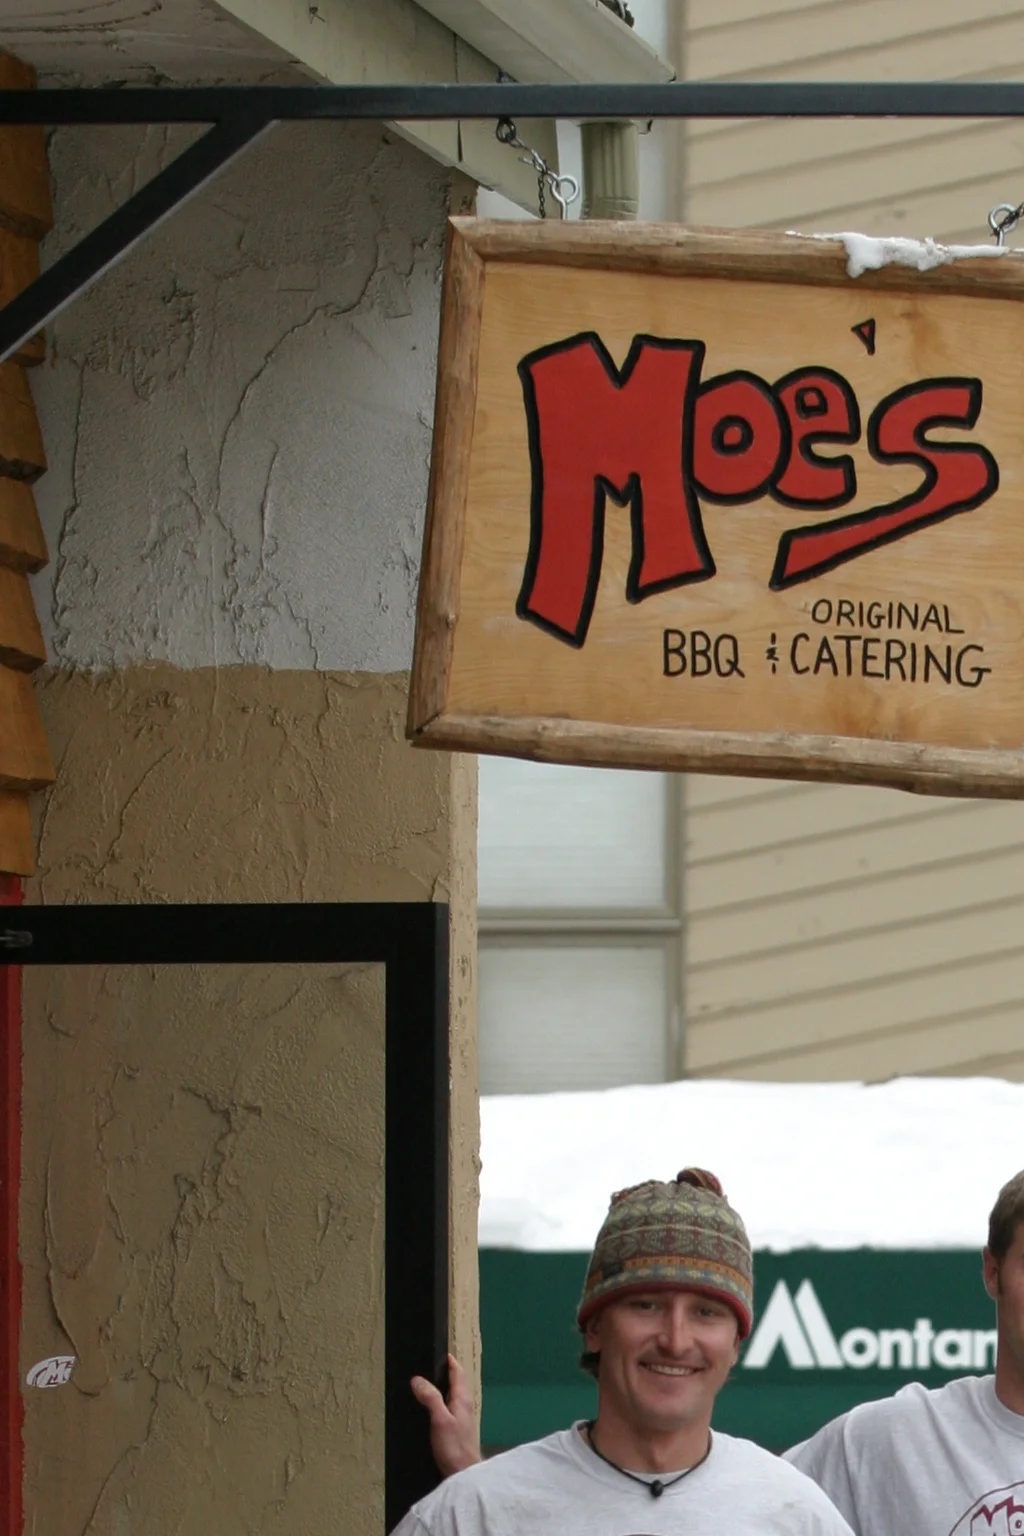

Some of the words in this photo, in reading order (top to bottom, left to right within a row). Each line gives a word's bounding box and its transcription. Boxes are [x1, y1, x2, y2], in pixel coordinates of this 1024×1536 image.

[516, 318, 998, 648] Moe's
[811, 598, 965, 634] ORIGINAL
[663, 628, 745, 679] BBQ
[790, 633, 992, 688] CATERING
